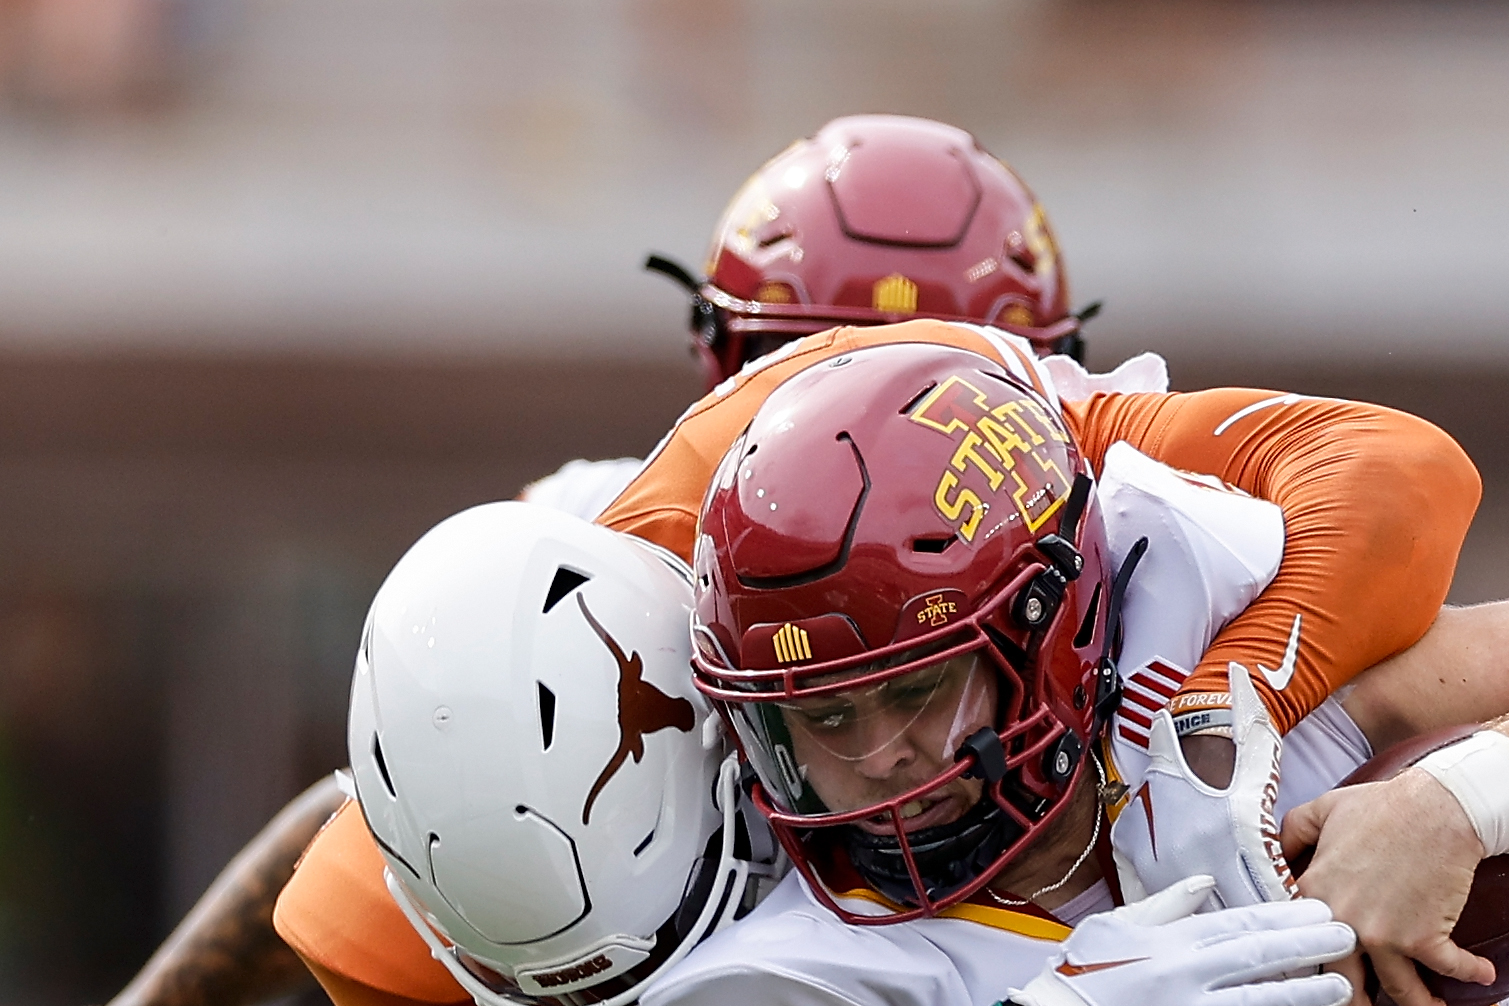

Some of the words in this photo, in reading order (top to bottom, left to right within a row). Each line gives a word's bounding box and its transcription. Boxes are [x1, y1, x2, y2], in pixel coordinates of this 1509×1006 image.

[935, 400, 1070, 541] STATE
[917, 602, 957, 624] STATE
[1179, 692, 1233, 709] FOREV
